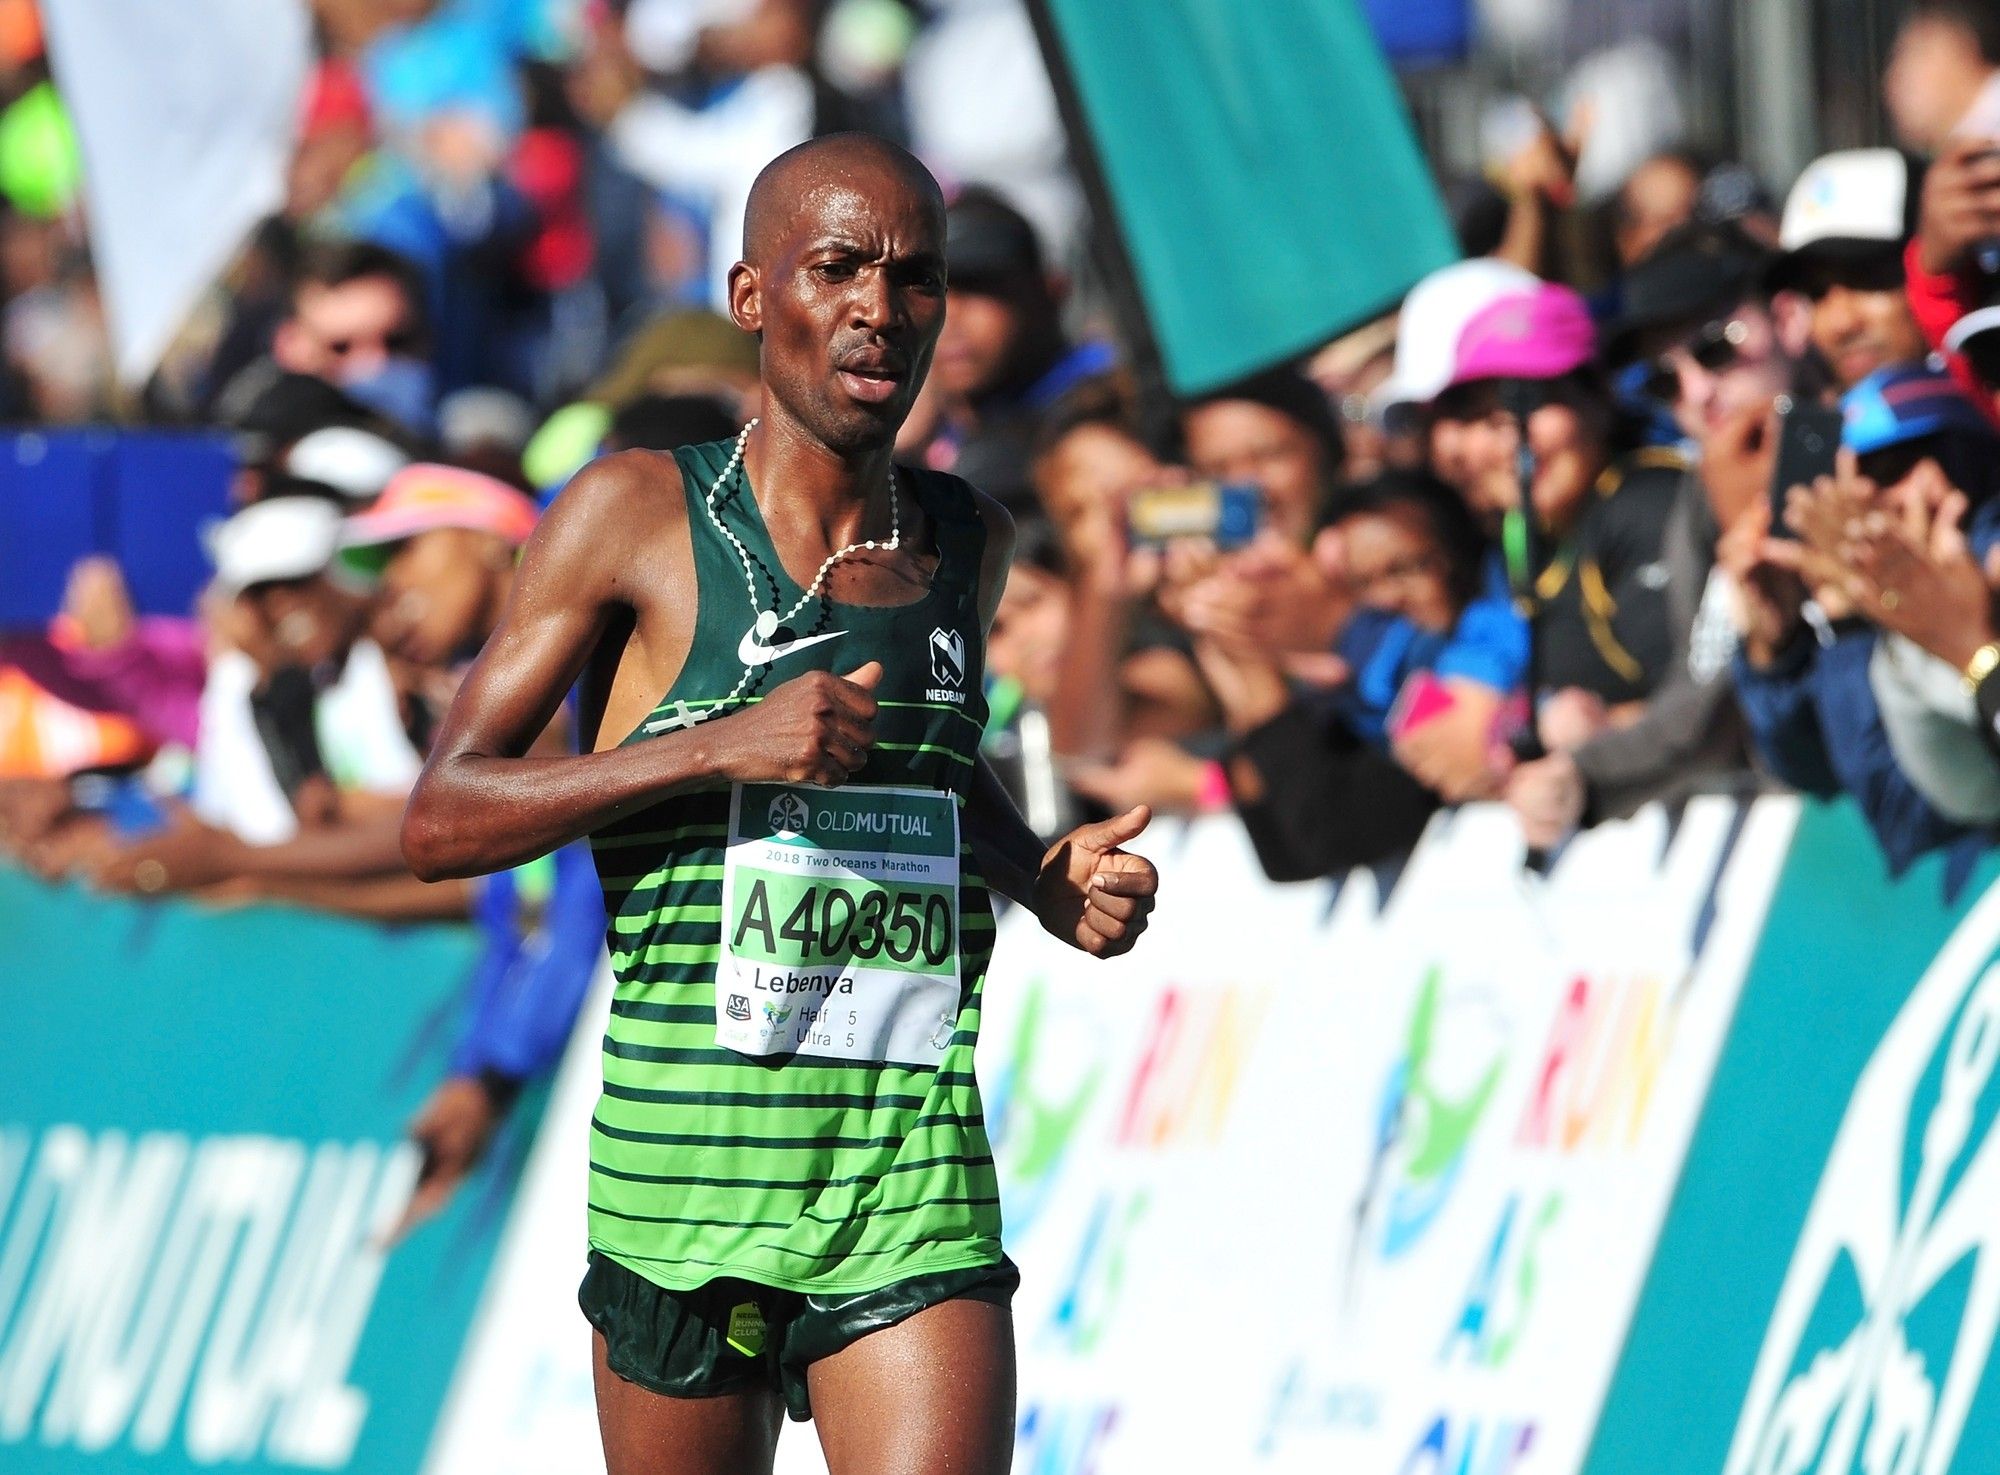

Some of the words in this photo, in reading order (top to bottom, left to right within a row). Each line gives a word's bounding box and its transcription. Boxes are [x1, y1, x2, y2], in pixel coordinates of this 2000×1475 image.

[765, 849, 800, 865] 2018
[805, 855, 829, 868] Two
[832, 857, 877, 871] Oceans
[881, 858, 931, 874] Marathon
[733, 878, 950, 967] A40350
[754, 967, 854, 999] Lebenya
[728, 994, 750, 1012] ASA
[799, 1006, 829, 1024] Half
[847, 1010, 858, 1026] 5
[796, 1027, 831, 1047] Ultra
[845, 1032, 856, 1048] 5
